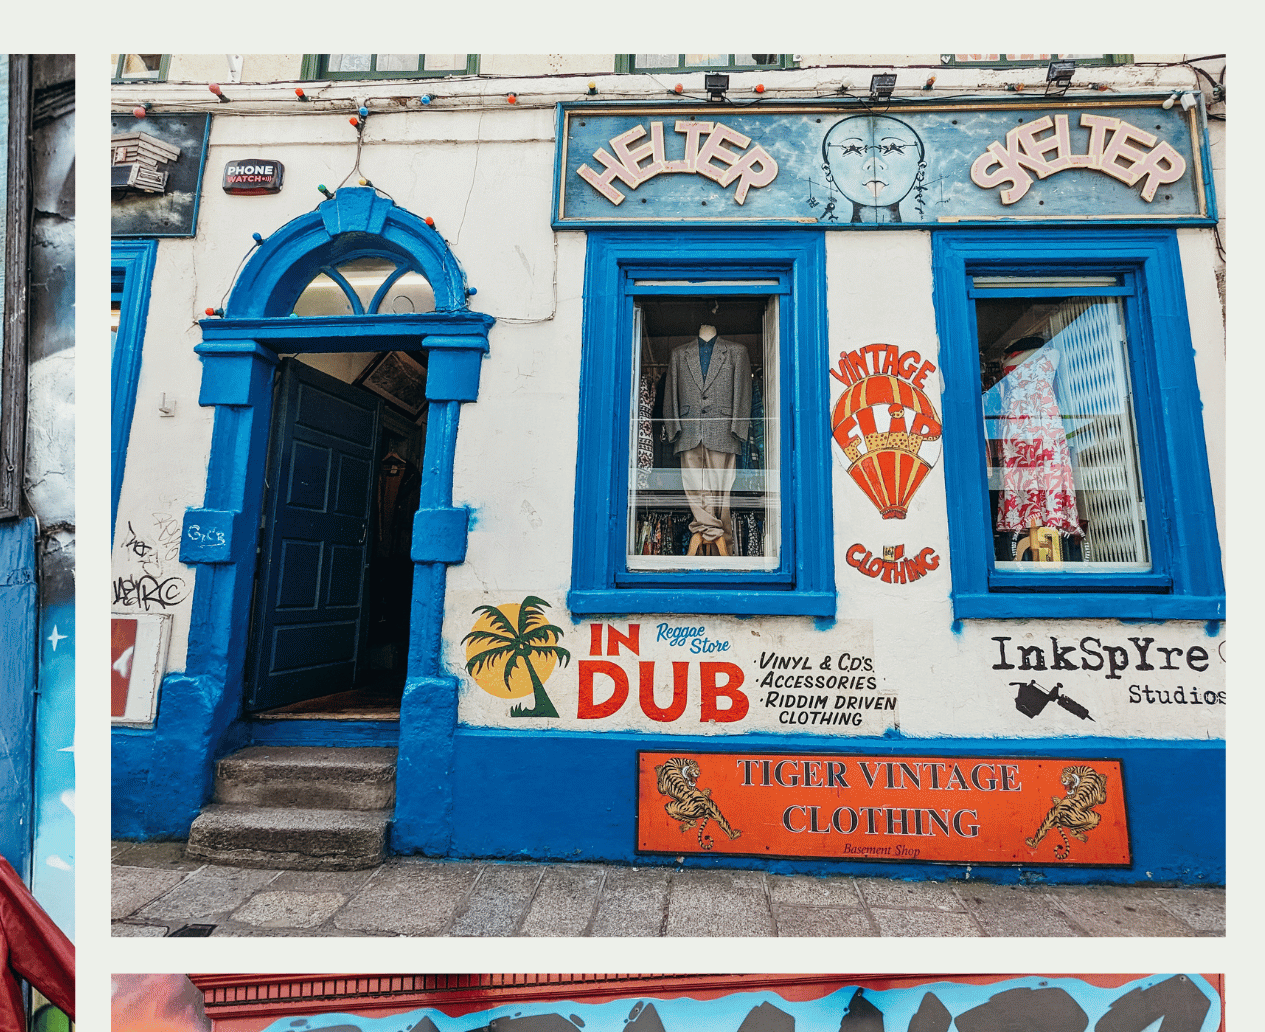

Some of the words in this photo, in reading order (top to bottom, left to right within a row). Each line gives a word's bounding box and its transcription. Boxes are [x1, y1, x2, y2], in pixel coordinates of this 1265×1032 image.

[227, 165, 274, 175] PHONE
[576, 120, 779, 206] HELTER
[970, 113, 1187, 205] SKELTER
[845, 543, 941, 584] CLOTHING
[589, 623, 641, 656] IN
[656, 622, 706, 647] Reggae
[689, 638, 731, 654] Store
[822, 655, 832, 671] &
[577, 659, 750, 723] DUB
[833, 693, 897, 711] DRIVEN
[778, 710, 863, 727] CLOTHING
[736, 759, 852, 789] TIGER
[856, 761, 1023, 793] VINTAGE
[781, 804, 981, 839] CLOTHING
[842, 843, 892, 857] Basement
[894, 844, 921, 858] Shop
